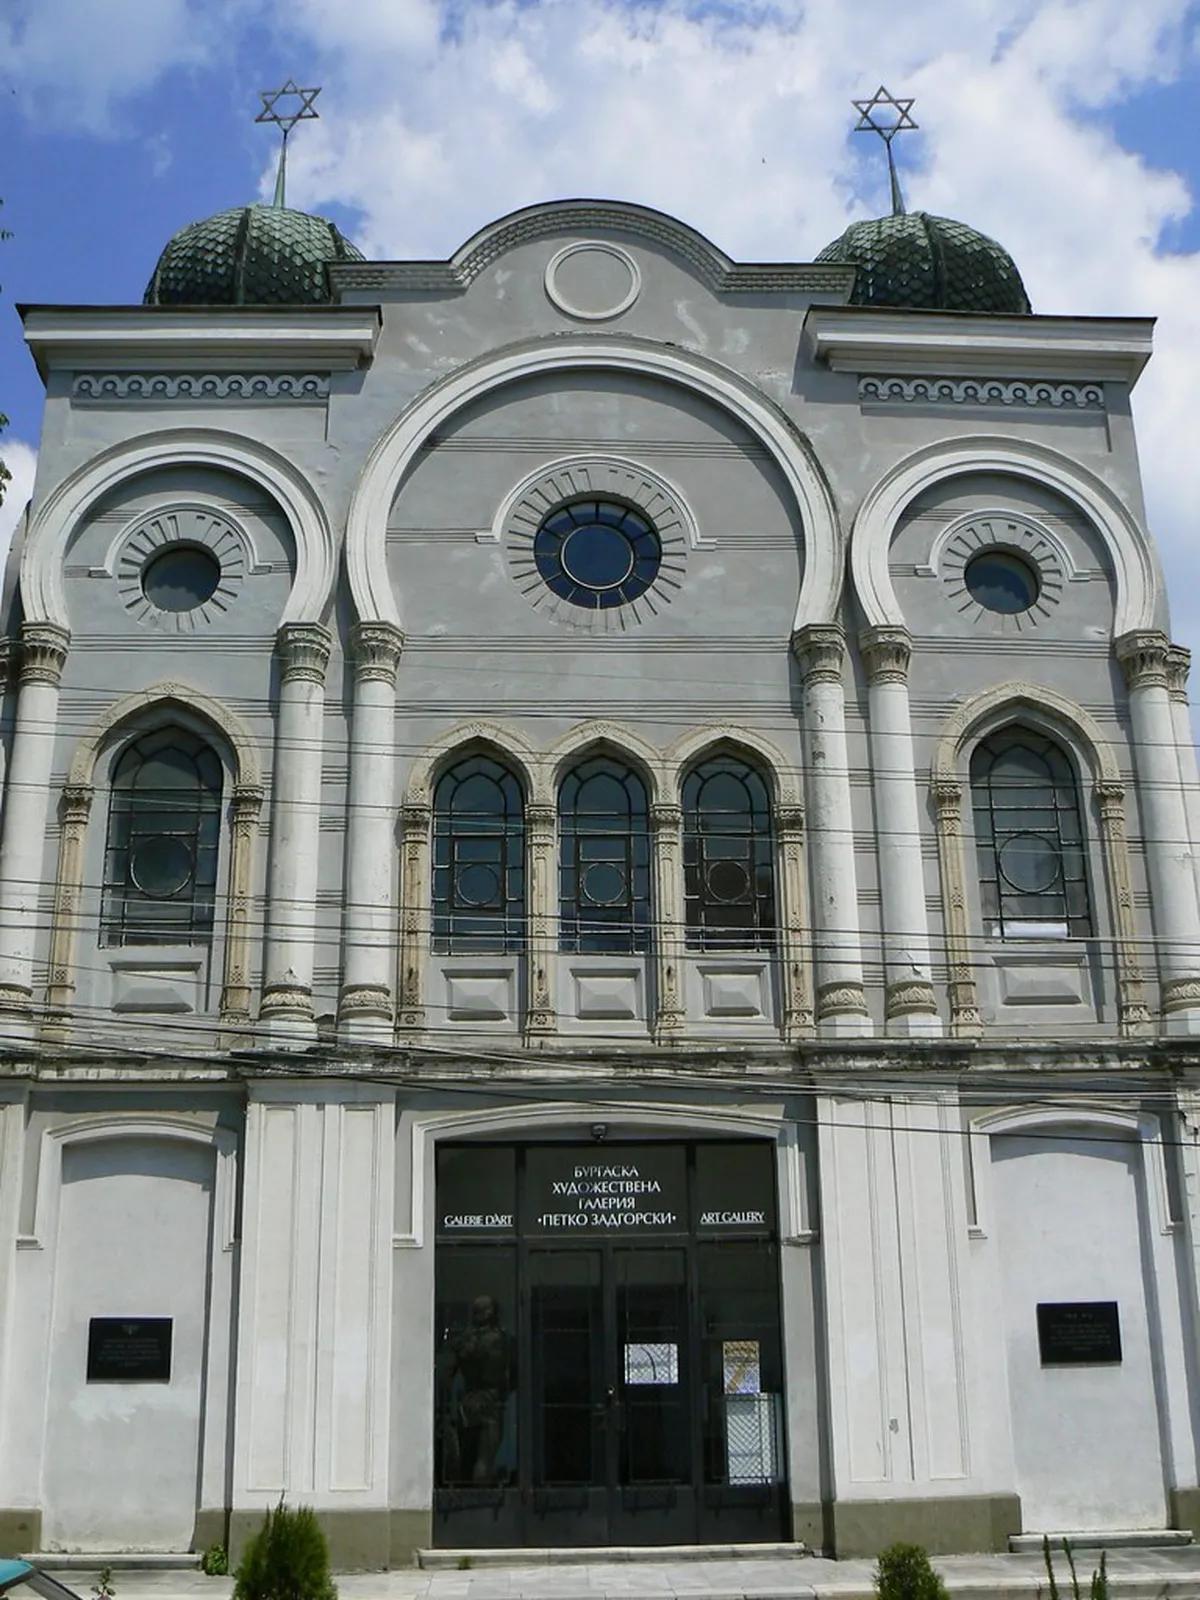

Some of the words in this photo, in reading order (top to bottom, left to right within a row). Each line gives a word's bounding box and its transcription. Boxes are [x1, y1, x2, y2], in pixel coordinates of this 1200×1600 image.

[574, 1165, 639, 1178] БУРГАСКА
[552, 1180, 662, 1195] ХУДОЖЕСТВЕНА
[578, 1196, 635, 1210] ГАЛЕРИЯ
[444, 1214, 484, 1227] GALERIE
[699, 1211, 721, 1225] ART
[721, 1211, 765, 1225] GALLERY
